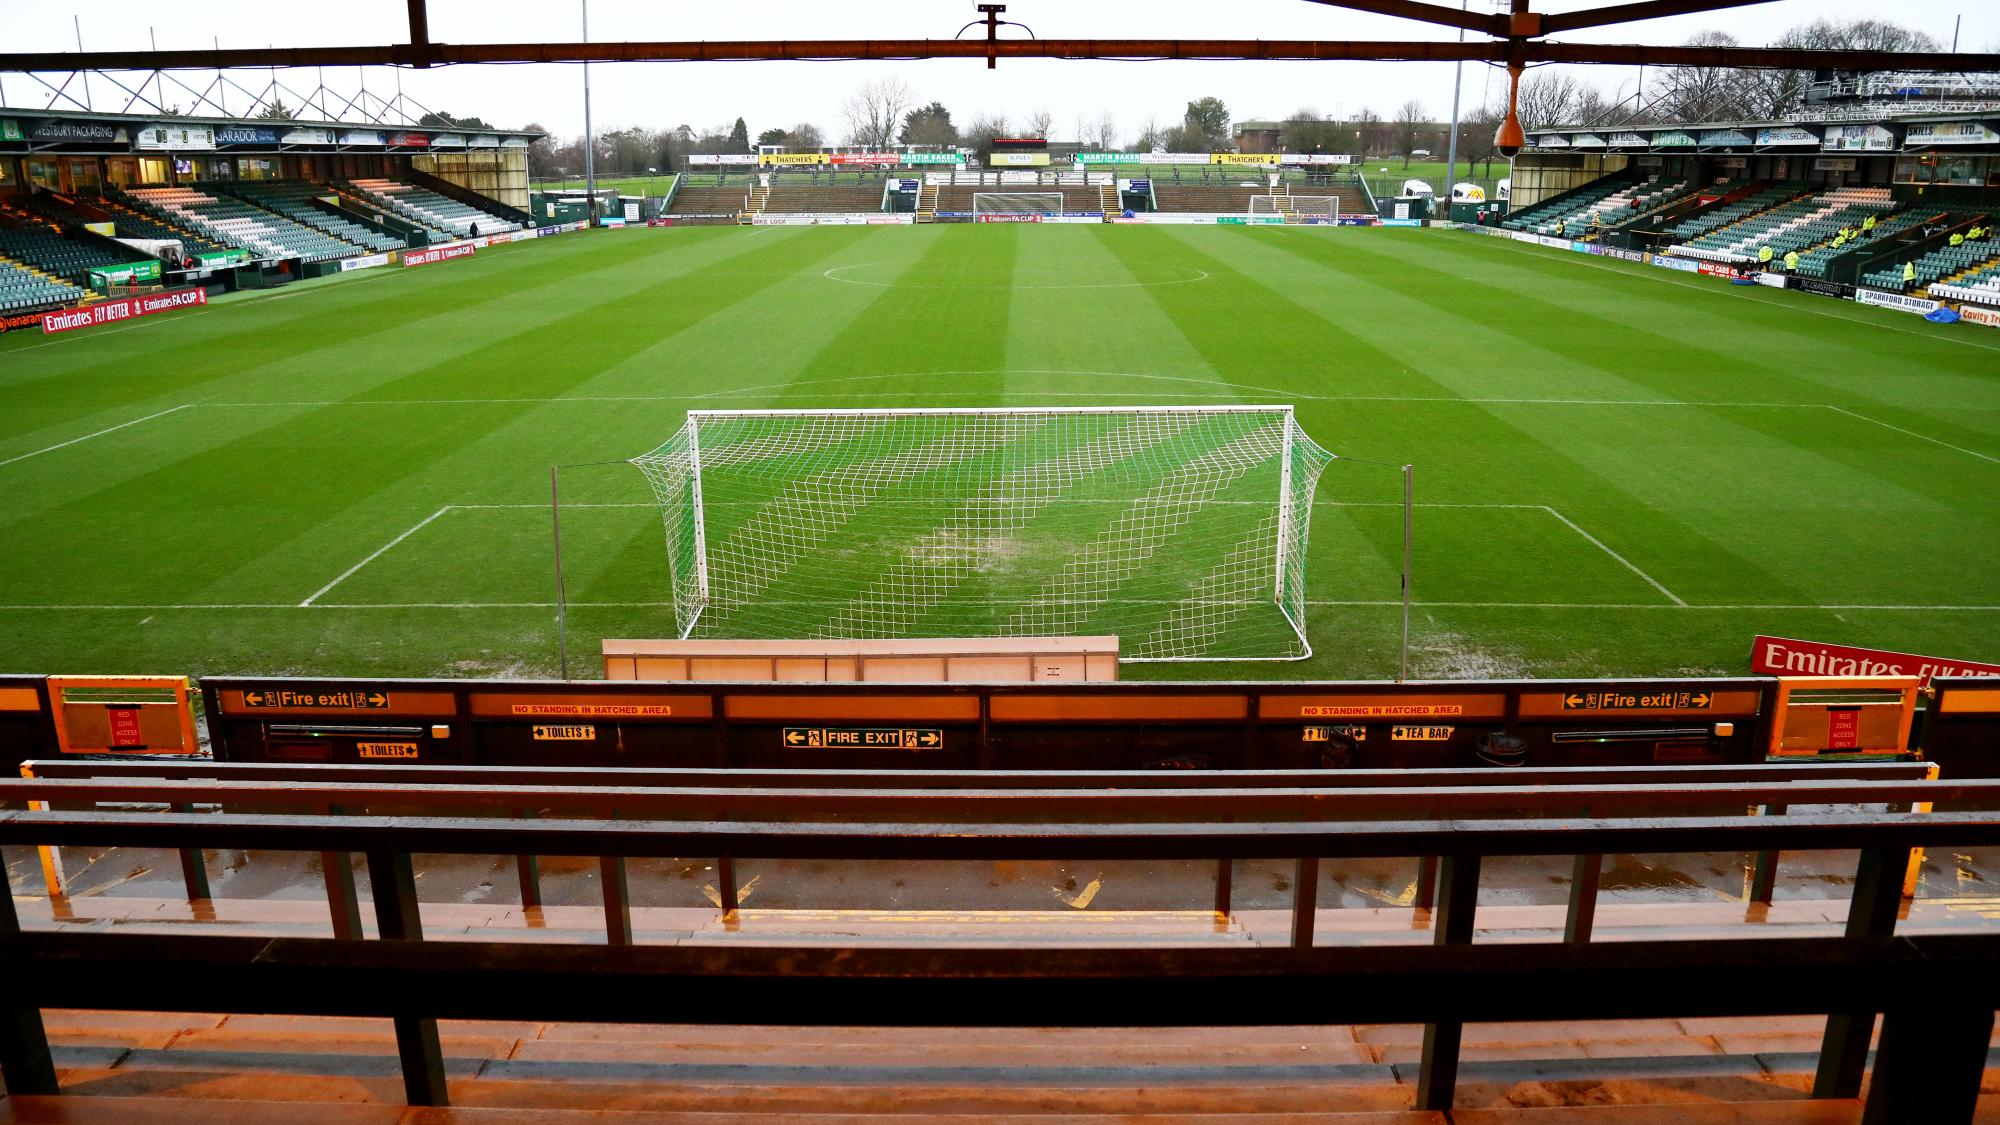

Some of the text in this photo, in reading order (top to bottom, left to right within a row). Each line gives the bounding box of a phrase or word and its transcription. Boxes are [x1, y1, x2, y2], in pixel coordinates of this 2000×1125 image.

[1907, 125, 1933, 137] SKILLS
[776, 155, 812, 164] THATCHERS
[1228, 155, 1265, 164] THATCHERS
[1698, 262, 1715, 273] RADIO
[1715, 265, 1730, 275] CABS
[1903, 296, 1934, 310] STORAGE
[46, 291, 197, 332] Emirates FLY BETTER Emirates FA CUP
[1963, 309, 1989, 324] Cavity
[7, 310, 43, 327] vanaram
[1765, 643, 1904, 677] Emirates
[282, 692, 350, 707] Fire exit
[1603, 693, 1672, 707] Fire exit
[514, 706, 668, 714] NO STANDING IN HATCHED AREA
[1303, 706, 1460, 715] NO STANDING IN HATCHED AREA
[547, 727, 582, 738] TOILETS
[828, 732, 899, 744] FIRE EXIT
[1406, 727, 1449, 739] TEA BAR
[370, 744, 405, 757] TOILETS
